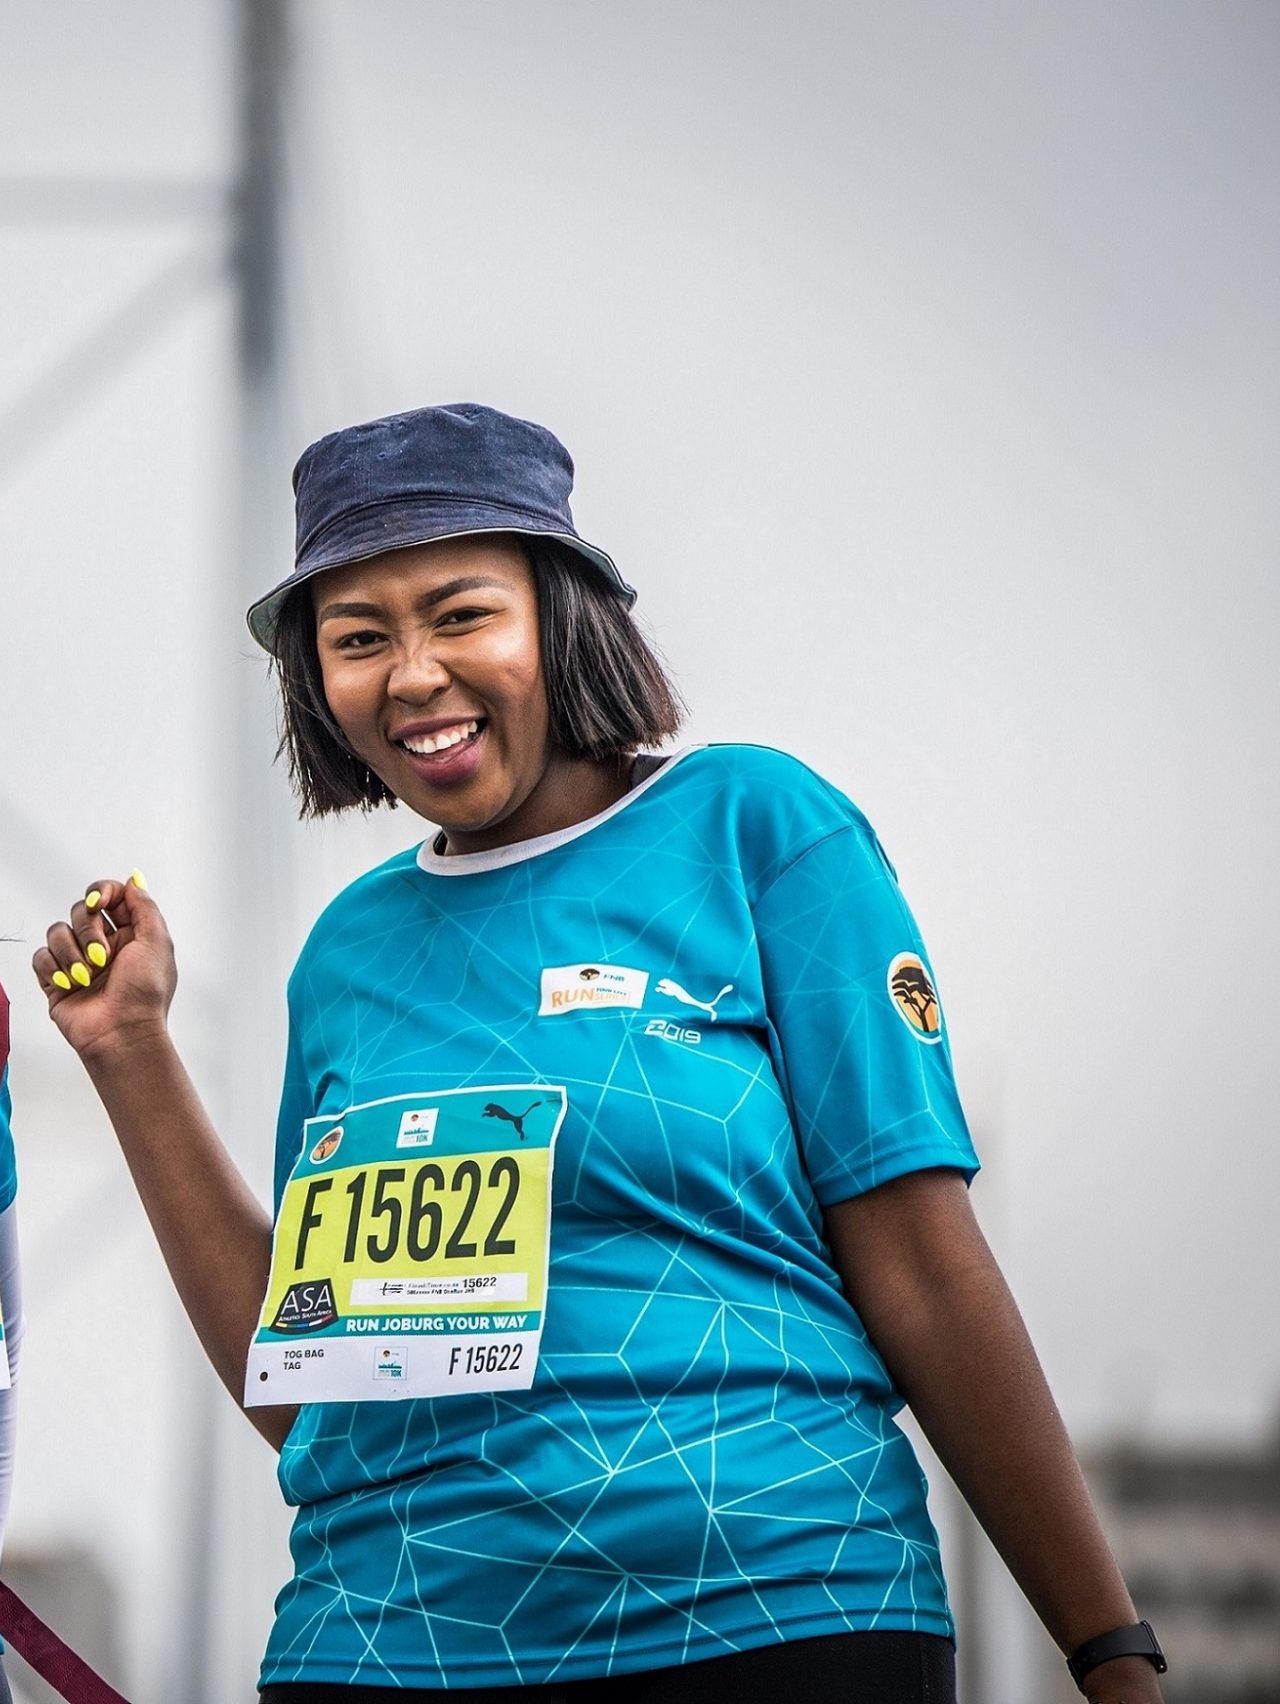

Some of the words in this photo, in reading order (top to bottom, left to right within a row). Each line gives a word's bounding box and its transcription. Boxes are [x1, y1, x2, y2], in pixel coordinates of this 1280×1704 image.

[551, 988, 595, 1008] RUN
[644, 1019, 701, 1044] 2019
[294, 1178, 334, 1271] F
[343, 1156, 520, 1264] 15622
[463, 1277, 497, 1288] 15622
[281, 1285, 332, 1315] ASA
[346, 1318, 379, 1332] RUN
[382, 1317, 444, 1331] JOBURG
[445, 1316, 490, 1330] YOUR
[493, 1315, 528, 1329] WAY
[284, 1350, 303, 1359] TOG
[304, 1349, 325, 1358] BAG
[448, 1347, 462, 1375] F
[465, 1343, 523, 1374] 15622
[283, 1361, 302, 1370] TAG
